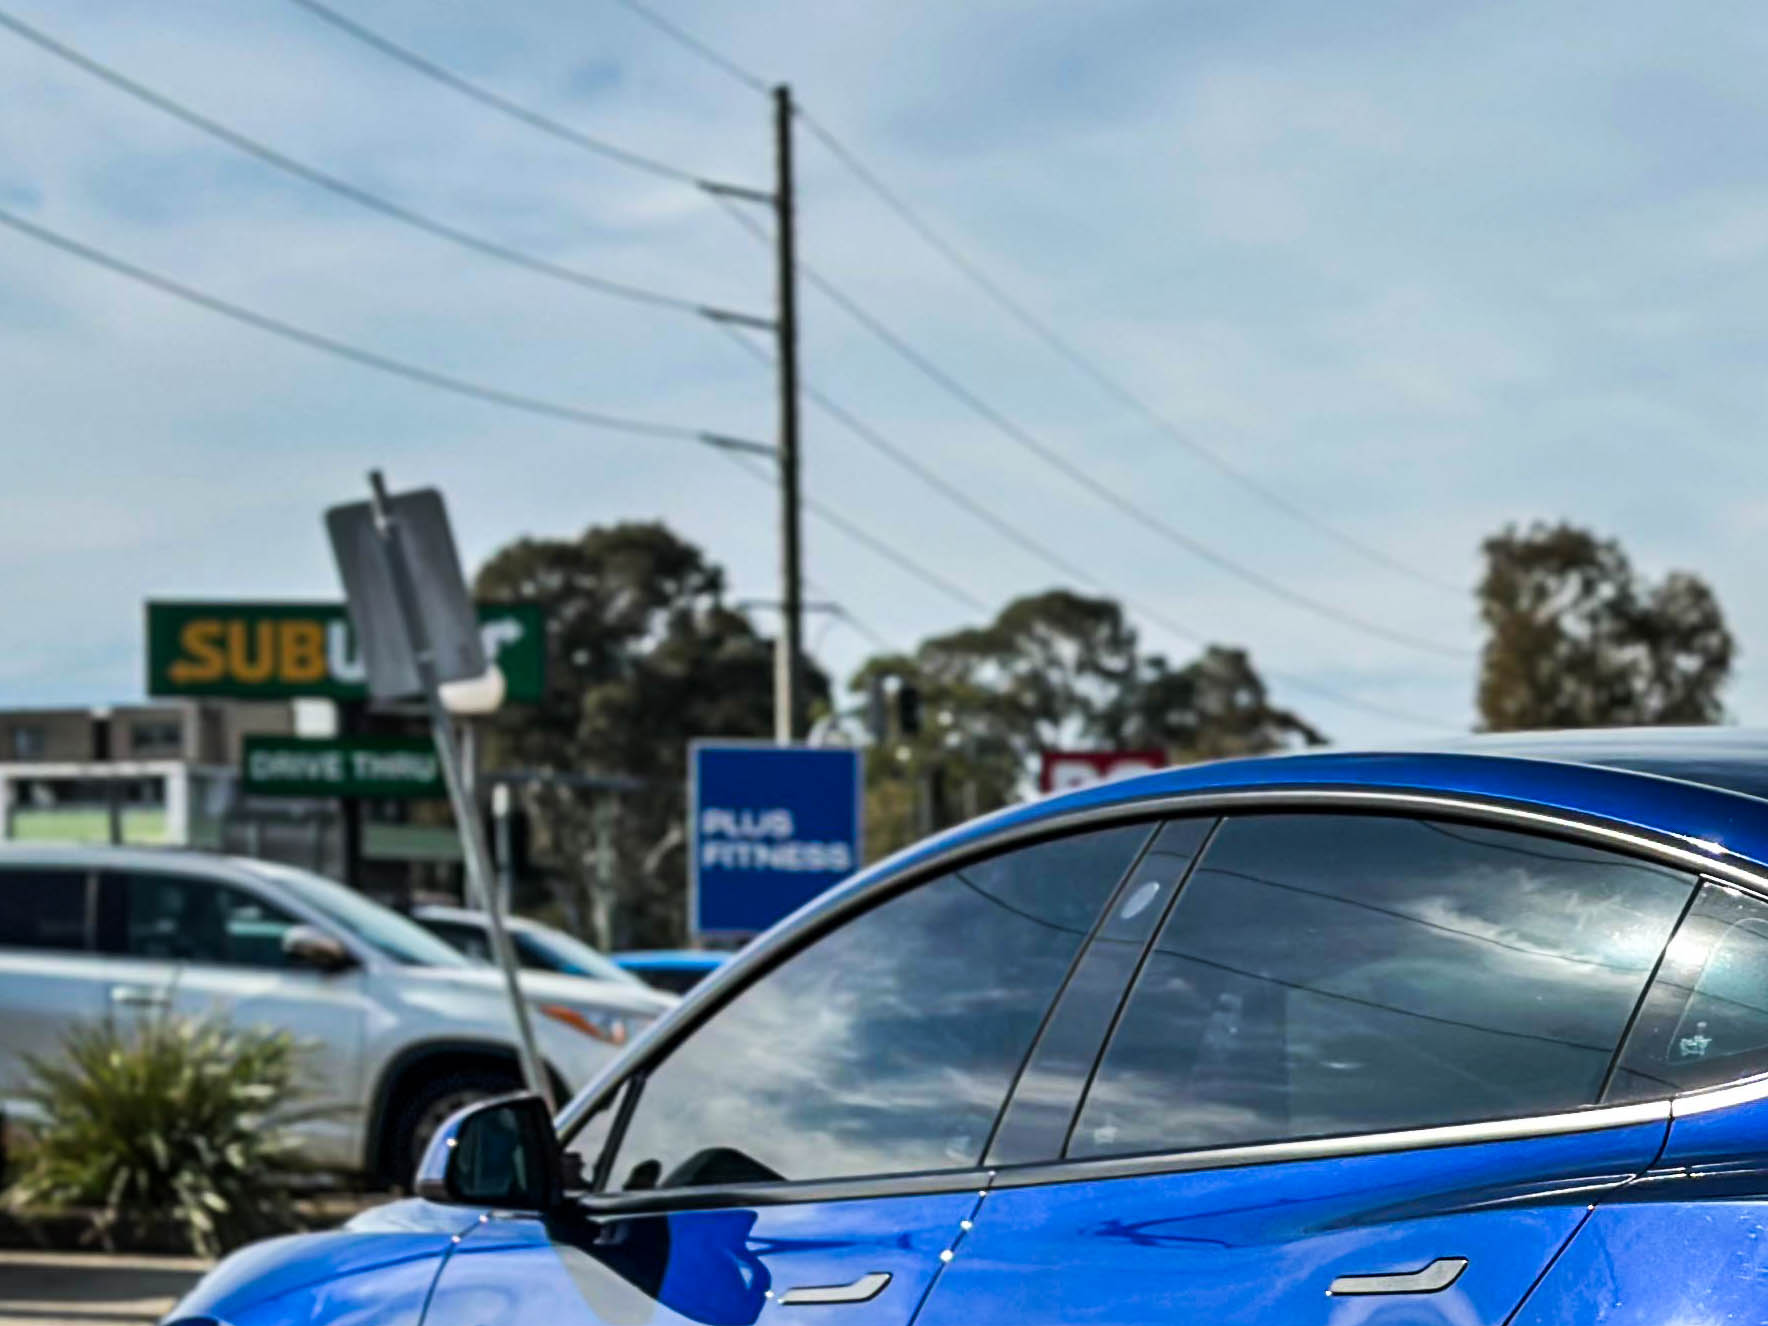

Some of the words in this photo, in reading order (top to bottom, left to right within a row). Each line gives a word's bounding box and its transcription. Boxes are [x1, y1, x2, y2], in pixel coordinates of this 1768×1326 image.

[249, 748, 344, 783] DRIVE
[352, 747, 437, 782] THRU
[702, 809, 794, 838] PLUS
[702, 840, 850, 872] FITNESS
